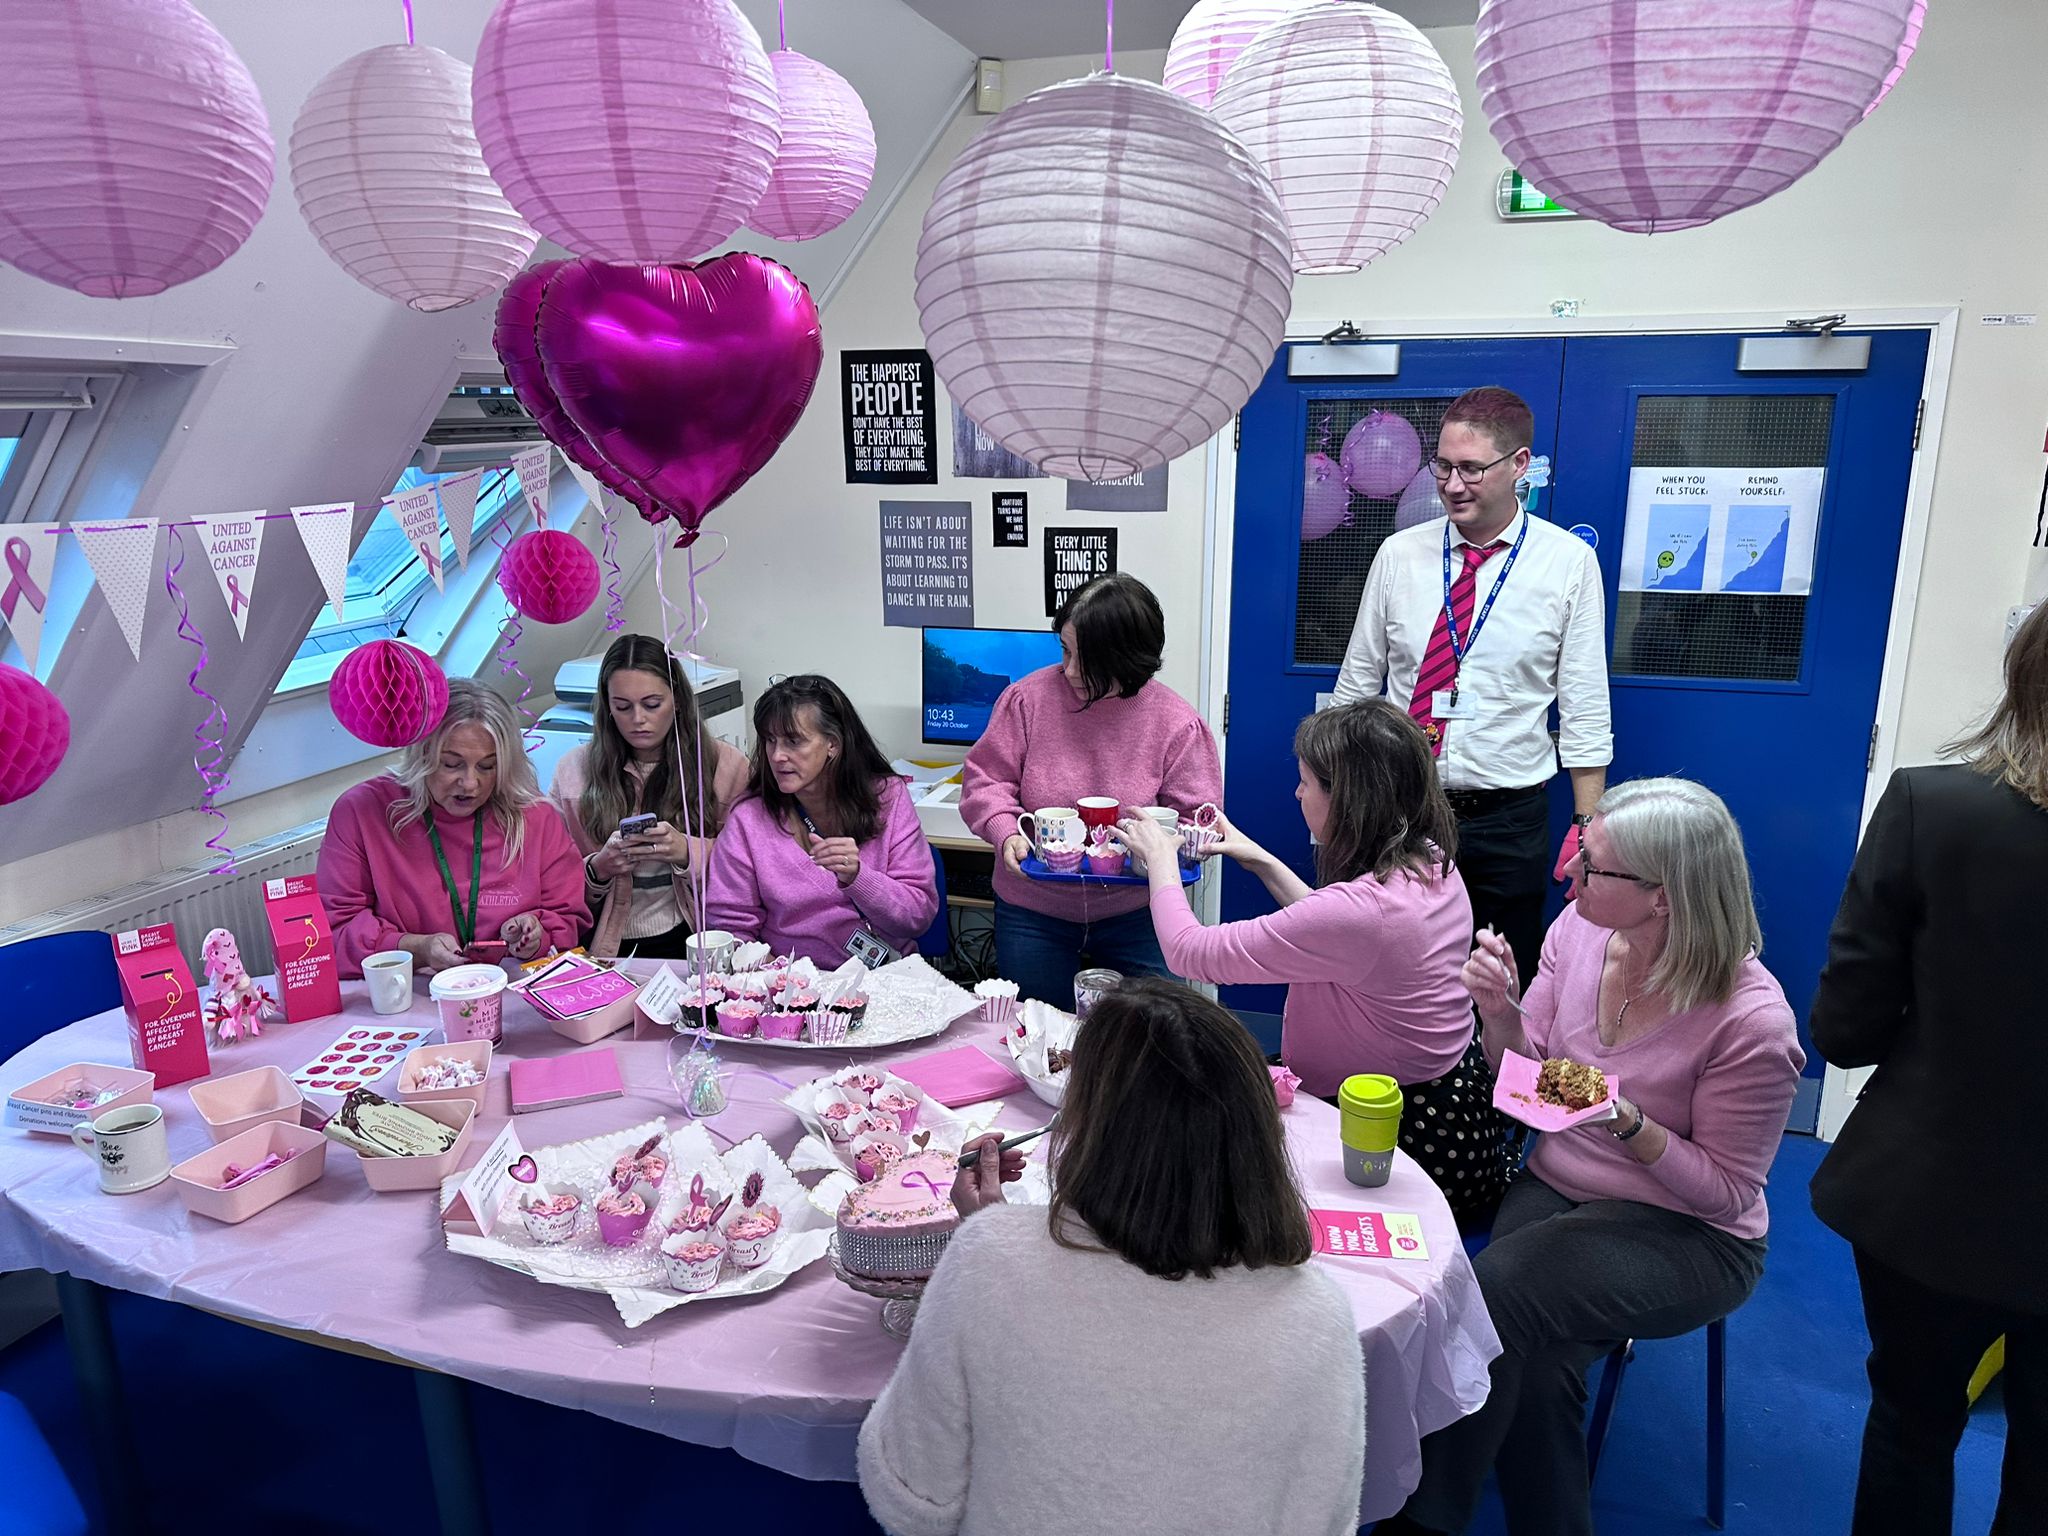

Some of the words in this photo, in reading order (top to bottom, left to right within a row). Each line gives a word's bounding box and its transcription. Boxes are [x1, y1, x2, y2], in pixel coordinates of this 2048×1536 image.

[850, 363, 869, 382] THE
[871, 363, 921, 382] HAPPIEST
[851, 382, 924, 416] PEOPLE
[852, 417, 872, 429] DON'T
[874, 417, 891, 429] HAVE
[891, 417, 905, 429] THE
[906, 417, 923, 429] BEST
[853, 429, 865, 445] OF
[867, 429, 927, 447] EVERYTHING,
[975, 436, 995, 451] NOW
[854, 446, 871, 458] THEY
[872, 446, 888, 458] JUST
[889, 446, 910, 458] MAKE
[911, 446, 925, 458] THE
[522, 453, 545, 469] UNITED
[855, 459, 872, 472] BEST
[873, 459, 882, 472] OF
[883, 459, 928, 472] EVERYTHING.
[522, 464, 547, 483] AGAINST
[1662, 476, 1684, 484] WHEN
[1687, 476, 1705, 484] YOU
[1748, 476, 1778, 485] REMIND
[524, 478, 548, 495] CANCER
[1655, 486, 1674, 495] FEEL
[399, 494, 428, 512] UNITED
[402, 507, 434, 527] AGAINST
[884, 515, 902, 529] LIFE
[906, 515, 931, 530] ISN'T
[935, 516, 967, 530] ABOUT
[212, 522, 252, 537] UNITED
[408, 521, 439, 541] CANCER
[210, 538, 256, 554] AGAINST
[884, 535, 923, 549] WAITING
[928, 536, 945, 549] FOR
[949, 536, 967, 550] THE
[1054, 536, 1079, 549] EVERY
[1082, 536, 1107, 549] LITTLE
[213, 554, 255, 570] CANCER
[885, 554, 912, 568] STORM
[914, 555, 924, 568] TO
[926, 556, 950, 569] PASS.
[952, 556, 968, 569] IT'S
[1054, 550, 1092, 572] THING
[1096, 550, 1108, 572] IS
[886, 574, 912, 587] ABOUT
[914, 575, 955, 588] LEARNING
[958, 575, 968, 589] TO
[887, 593, 914, 606] DANCE
[916, 594, 925, 607] IN
[928, 594, 944, 607] THE
[947, 594, 972, 608] RAIN.
[1480, 604, 1490, 621] STAFF
[1451, 630, 1459, 646] STAFF
[928, 708, 954, 721] 10:43
[927, 720, 941, 728] Friday
[480, 895, 520, 906] ATHLETICS
[285, 960, 298, 969] FOR
[299, 954, 331, 966] EVERYONE
[286, 964, 318, 976] AFFECTED
[287, 974, 296, 983] BY
[296, 970, 320, 980] BREAST
[288, 979, 314, 990] CANCER
[482, 1006, 500, 1017] MIN
[144, 1020, 159, 1030] FOR
[160, 1010, 197, 1025] EVERYONE
[146, 1022, 182, 1037] AFFECTED
[147, 1035, 157, 1045] BY
[158, 1029, 185, 1041] BREAST
[148, 1039, 177, 1052] CANCER
[21, 1104, 40, 1114] Cancer
[40, 1108, 52, 1116] pins
[53, 1109, 64, 1117] and
[19, 1115, 47, 1126] Donations
[48, 1120, 74, 1128] welcome
[101, 1140, 122, 1151] Bee
[1326, 1225, 1345, 1250] KNOW
[1344, 1229, 1362, 1252] YOUR
[1357, 1216, 1380, 1253] BREASTS
